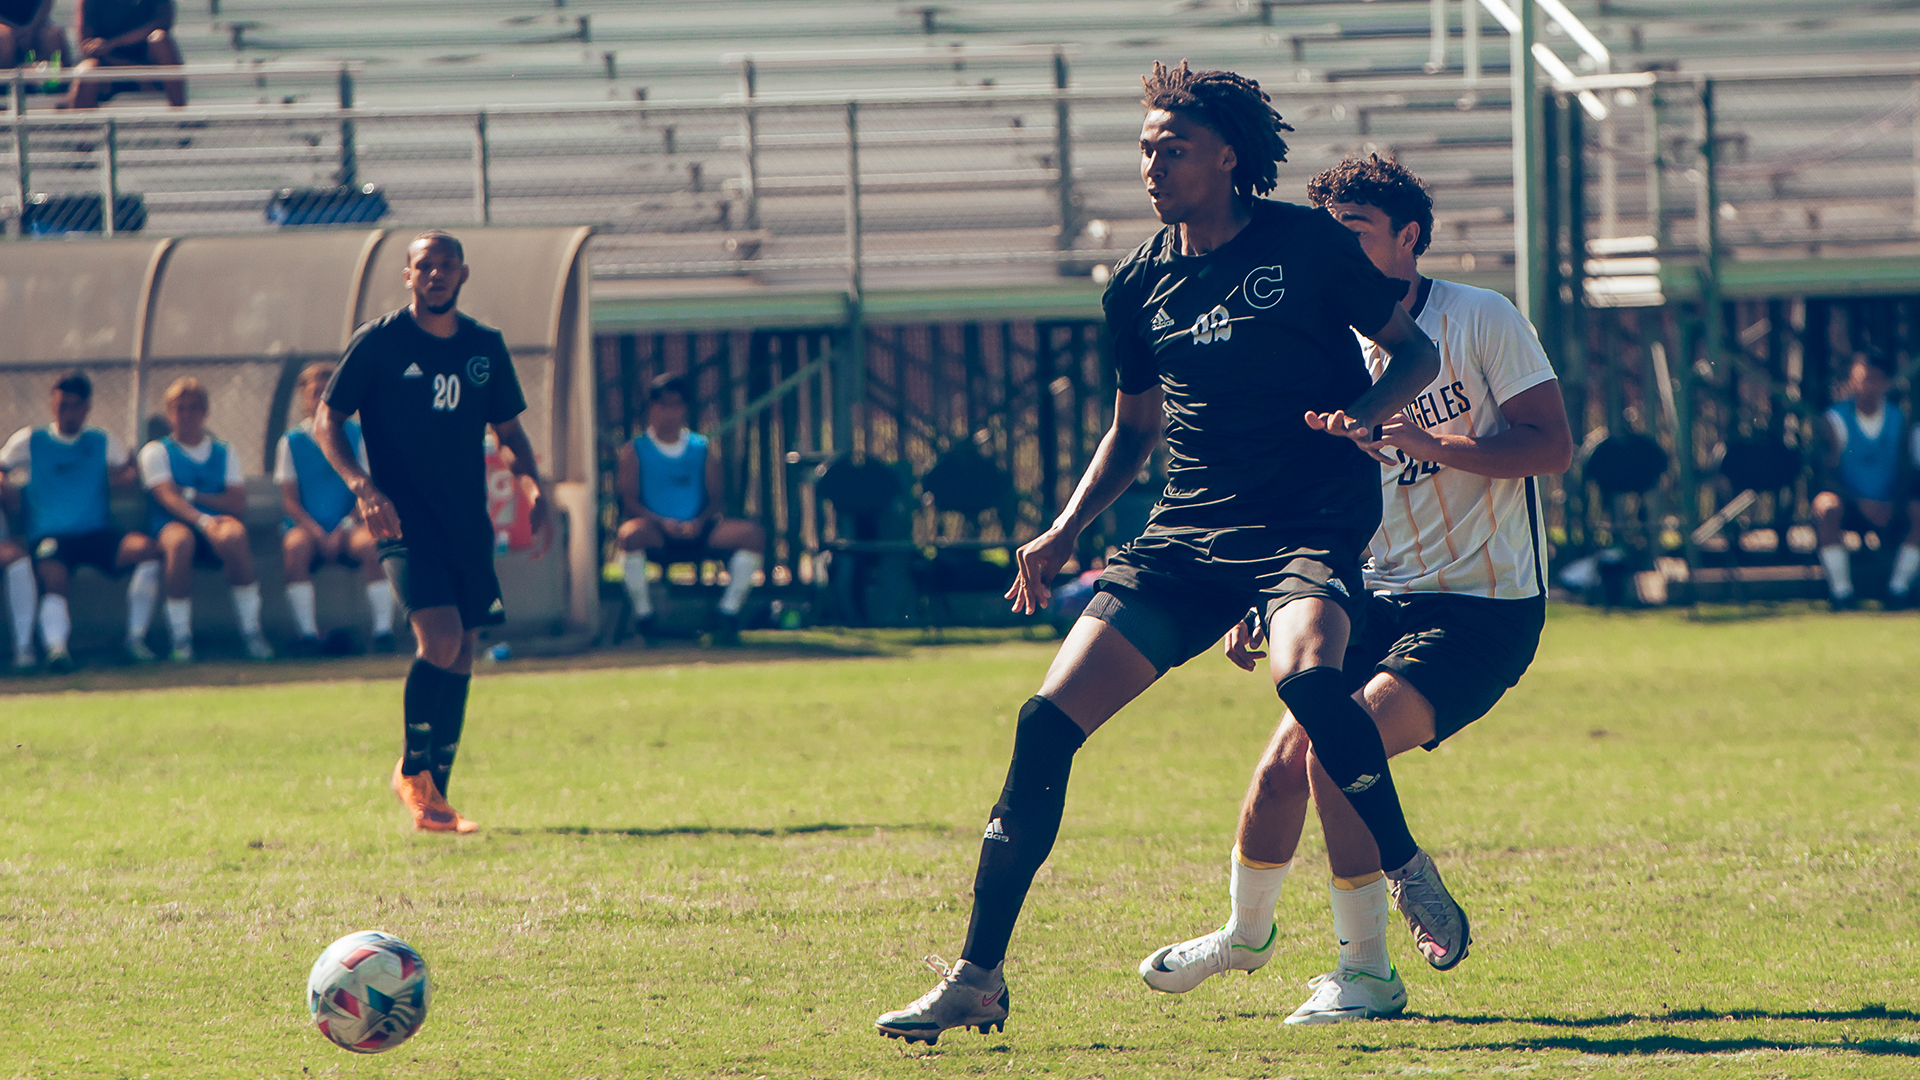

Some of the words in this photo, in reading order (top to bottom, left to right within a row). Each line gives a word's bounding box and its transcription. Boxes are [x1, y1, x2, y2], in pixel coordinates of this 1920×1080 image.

[1243, 265, 1285, 309] C
[466, 356, 491, 386] C
[432, 373, 461, 411] 20
[1404, 380, 1472, 430] GELES
